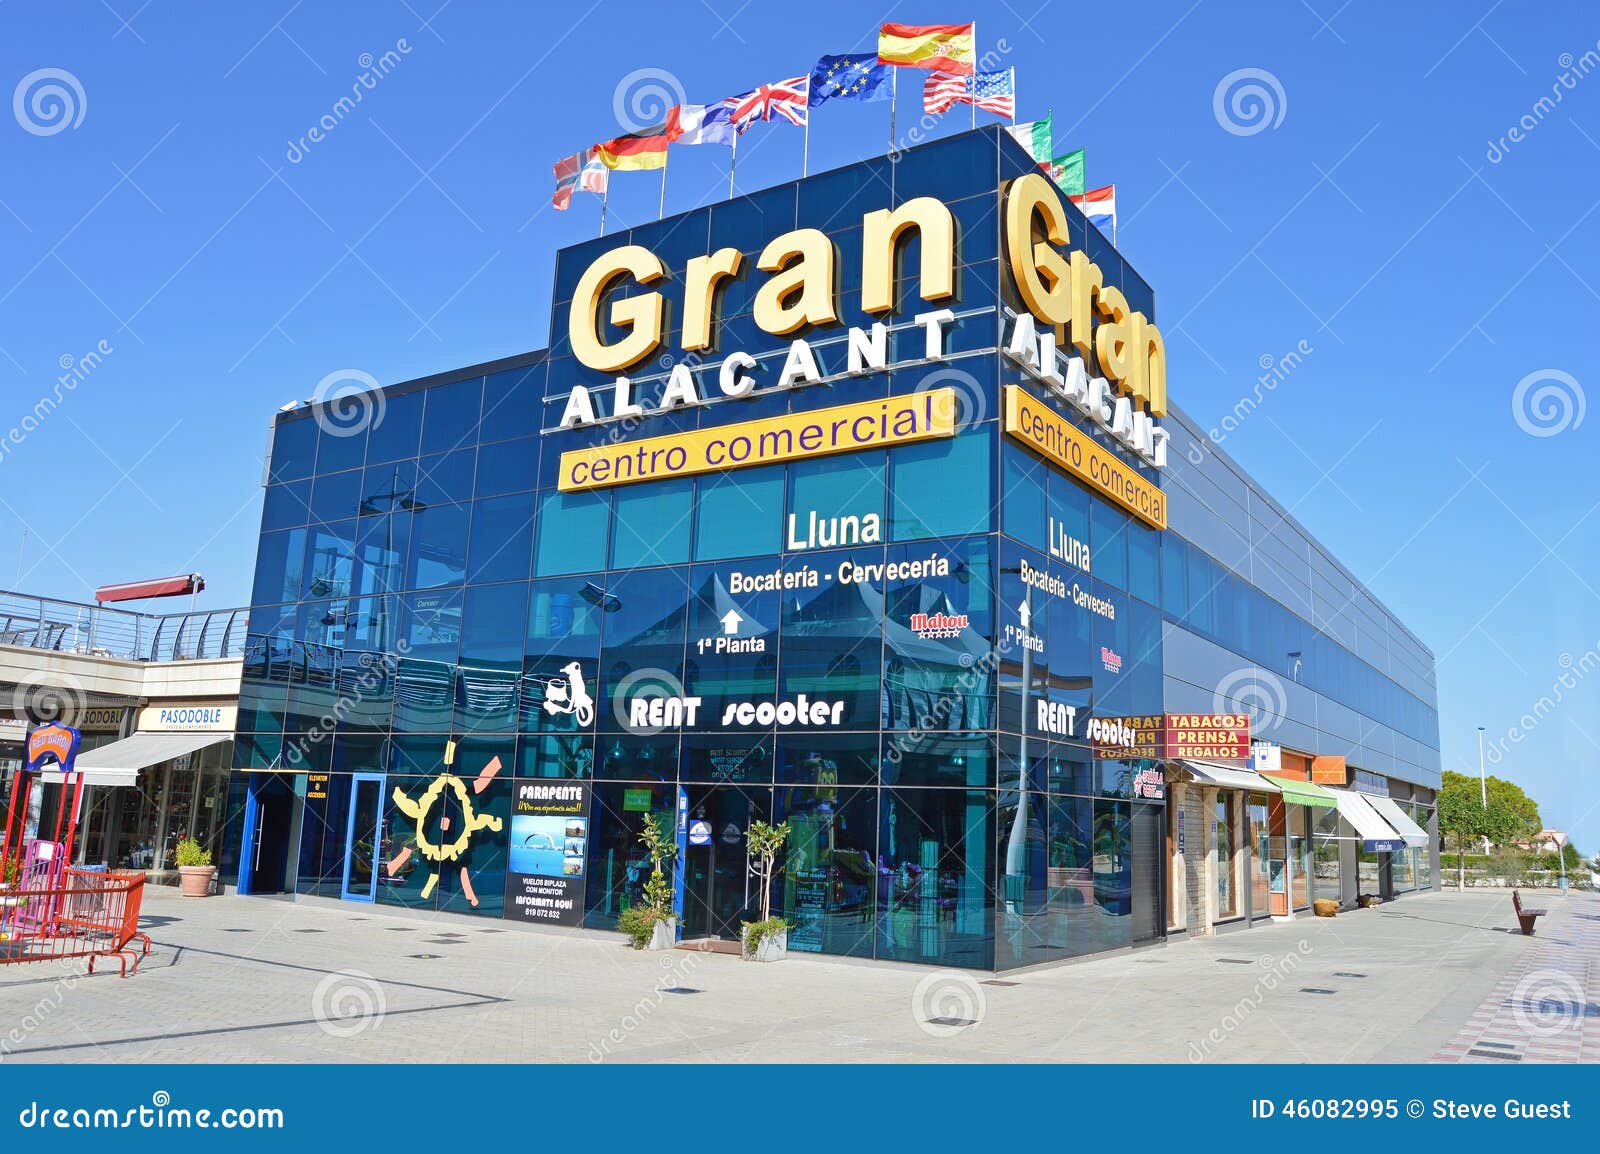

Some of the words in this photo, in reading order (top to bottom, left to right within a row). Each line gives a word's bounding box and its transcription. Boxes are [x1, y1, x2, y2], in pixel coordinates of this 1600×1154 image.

[569, 197, 955, 372] Gran
[1006, 173, 1167, 418] Gran
[560, 308, 954, 427] ALACANT
[1009, 312, 1170, 468] ALACANT
[570, 445, 687, 485] centro
[705, 396, 933, 465] comercial
[1020, 406, 1082, 468] centro
[1089, 454, 1165, 524] comercial
[787, 511, 881, 550] Lluna
[1050, 517, 1091, 573] Lluna
[729, 565, 819, 595] Bocatería
[838, 553, 950, 585] Cervecería
[1021, 558, 1066, 599] Bocatería
[910, 613, 969, 633] Mahou
[1016, 627, 1044, 653] Planta
[715, 636, 765, 654] Planta
[160, 708, 221, 724] PASODOBLE
[630, 697, 701, 727] RENT
[721, 694, 844, 727] scooter
[1037, 699, 1076, 737] RENT
[1086, 717, 1136, 748] scooter
[1171, 714, 1246, 729] TABACOS
[1177, 730, 1239, 744] PRENSA
[1178, 746, 1239, 759] REGALOS
[520, 785, 583, 801] PARAPENTE
[522, 877, 544, 886] VUELOS
[544, 879, 567, 888] BIPLAZA
[525, 886, 538, 894] CON
[538, 887, 564, 896] MONITOR
